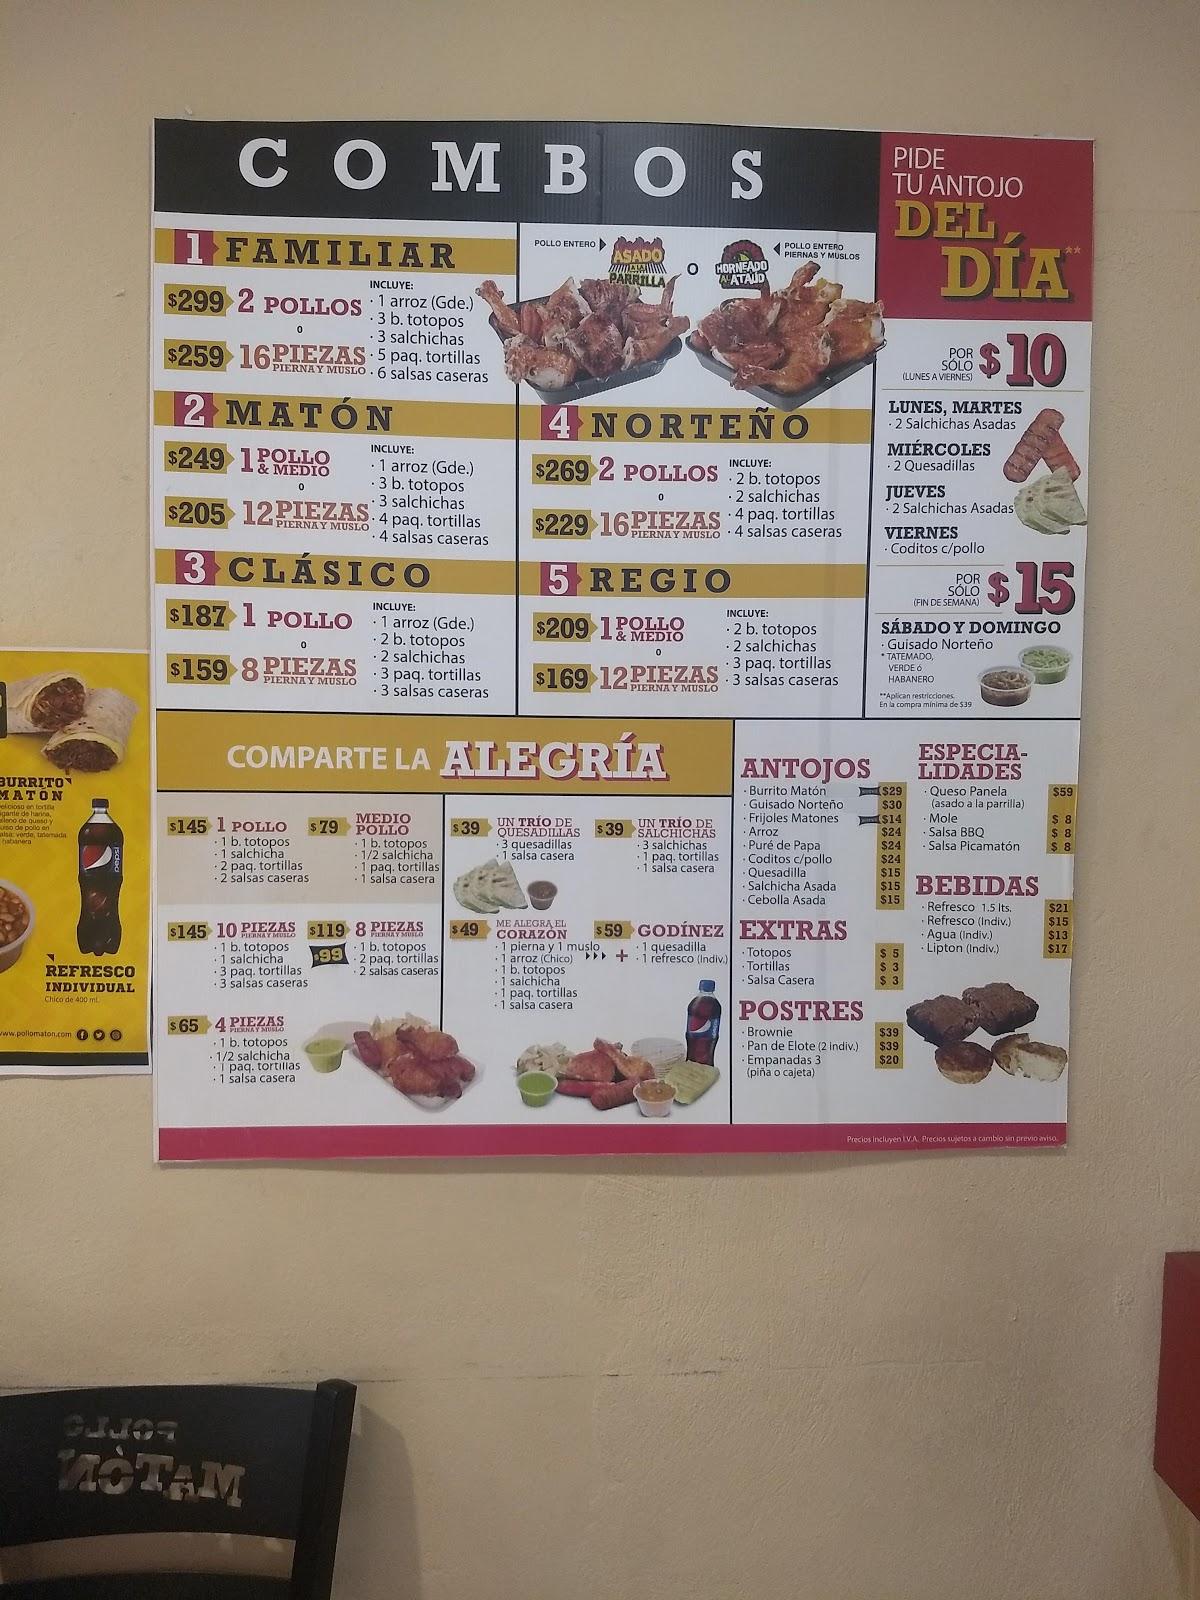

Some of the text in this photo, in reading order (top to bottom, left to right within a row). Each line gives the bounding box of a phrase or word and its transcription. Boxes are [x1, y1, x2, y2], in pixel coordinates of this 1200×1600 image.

[894, 146, 944, 169] PIDE
[238, 137, 763, 200] COMBOS
[892, 173, 1023, 197] TU ANTOJO
[895, 200, 996, 239] DEL
[186, 233, 456, 269] 1 FAMILIAR
[534, 240, 596, 248] POLLO ENTERO
[614, 250, 663, 263] ASADO
[784, 251, 818, 259] PIERNAS
[827, 252, 860, 261] MUSLOS
[716, 261, 768, 274] HORNEADO
[370, 280, 413, 290] INCLUYE:
[610, 273, 665, 288] PARRILLA
[168, 288, 362, 316] $299 2 POLLOS
[379, 295, 474, 311] 1 arroz (Gde.)
[168, 344, 366, 369] $259 16 PIEZAS
[378, 349, 480, 366] 5 paq. tortillas
[950, 348, 973, 359] POR
[979, 333, 1067, 387] $10
[272, 365, 366, 376] PIERNA Y MUSLO
[942, 359, 973, 371] SÓLO
[903, 372, 930, 381] (LUNES
[940, 372, 973, 382] VIERNES)
[184, 394, 392, 431] 2 MATÓN
[889, 400, 1022, 416] LUNES, MARTES
[548, 407, 809, 440] 4 NORTEÑO
[895, 418, 1015, 430] 2 Salchichas Asadas
[887, 440, 990, 456] MIÉRCOLES
[168, 447, 330, 472] $249 1 POLLO
[258, 464, 330, 477] & MEDIO
[536, 460, 589, 482] $269
[886, 485, 945, 501] JUEVES
[169, 500, 369, 525] $205 12 PIEZAS
[884, 527, 958, 539] VIERNES
[891, 542, 984, 556] Coditos c/pollo
[184, 552, 430, 588] 3 CLÁSICO
[549, 564, 731, 595] 5 REGIO
[988, 562, 1075, 615] $15
[170, 605, 226, 626] $187
[537, 618, 589, 638] $209
[882, 618, 1061, 634] SÁBADO Y DOMINGO
[888, 639, 993, 650] Guisado Norteño
[887, 653, 934, 661] TATEMADO,
[889, 664, 915, 672] VERDE
[889, 675, 934, 683] HABANERO
[227, 732, 670, 781] COMPARTE LA ALEGRÍA
[918, 744, 1028, 761] ESPECIA-
[741, 758, 870, 784] ANTOJOS
[918, 763, 1022, 780] LIDADES
[749, 786, 787, 795] Burrito
[790, 786, 826, 795] Matón
[882, 787, 902, 796] $29
[930, 786, 1073, 798] Queso Panela $59
[170, 817, 287, 834] $145 1 POLLO
[356, 813, 411, 824] MEDIO
[453, 816, 572, 835] $39 UN TRÍO DE
[749, 813, 787, 825] Frijoles
[792, 813, 838, 823] Matones
[882, 814, 901, 824] $14
[311, 820, 338, 834] $79
[356, 825, 409, 836] POLLO
[497, 828, 580, 839] QUESADILLAS
[929, 840, 1020, 852] Salsa Picamatón
[916, 875, 1039, 896] BEBIDAS
[927, 902, 975, 912] Refresco
[982, 904, 995, 912] 1.5
[496, 919, 566, 928] ME ALEGRA EL
[597, 923, 622, 937] $59
[637, 921, 723, 937] GODÍNEZ
[739, 920, 847, 940] EXTRAS
[496, 926, 567, 939] CORAZÓN
[45, 965, 135, 978] REFRESCO
[45, 982, 135, 992] INDIVIDUAL
[739, 1000, 863, 1021] POSTRES
[170, 1019, 198, 1033] $65
[748, 1027, 899, 1037] Brownie $39
[847, 1135, 871, 1143] Precios
[922, 1135, 946, 1143] Precios
[948, 1135, 971, 1144] sujetos
[1016, 1135, 1037, 1143] previo
